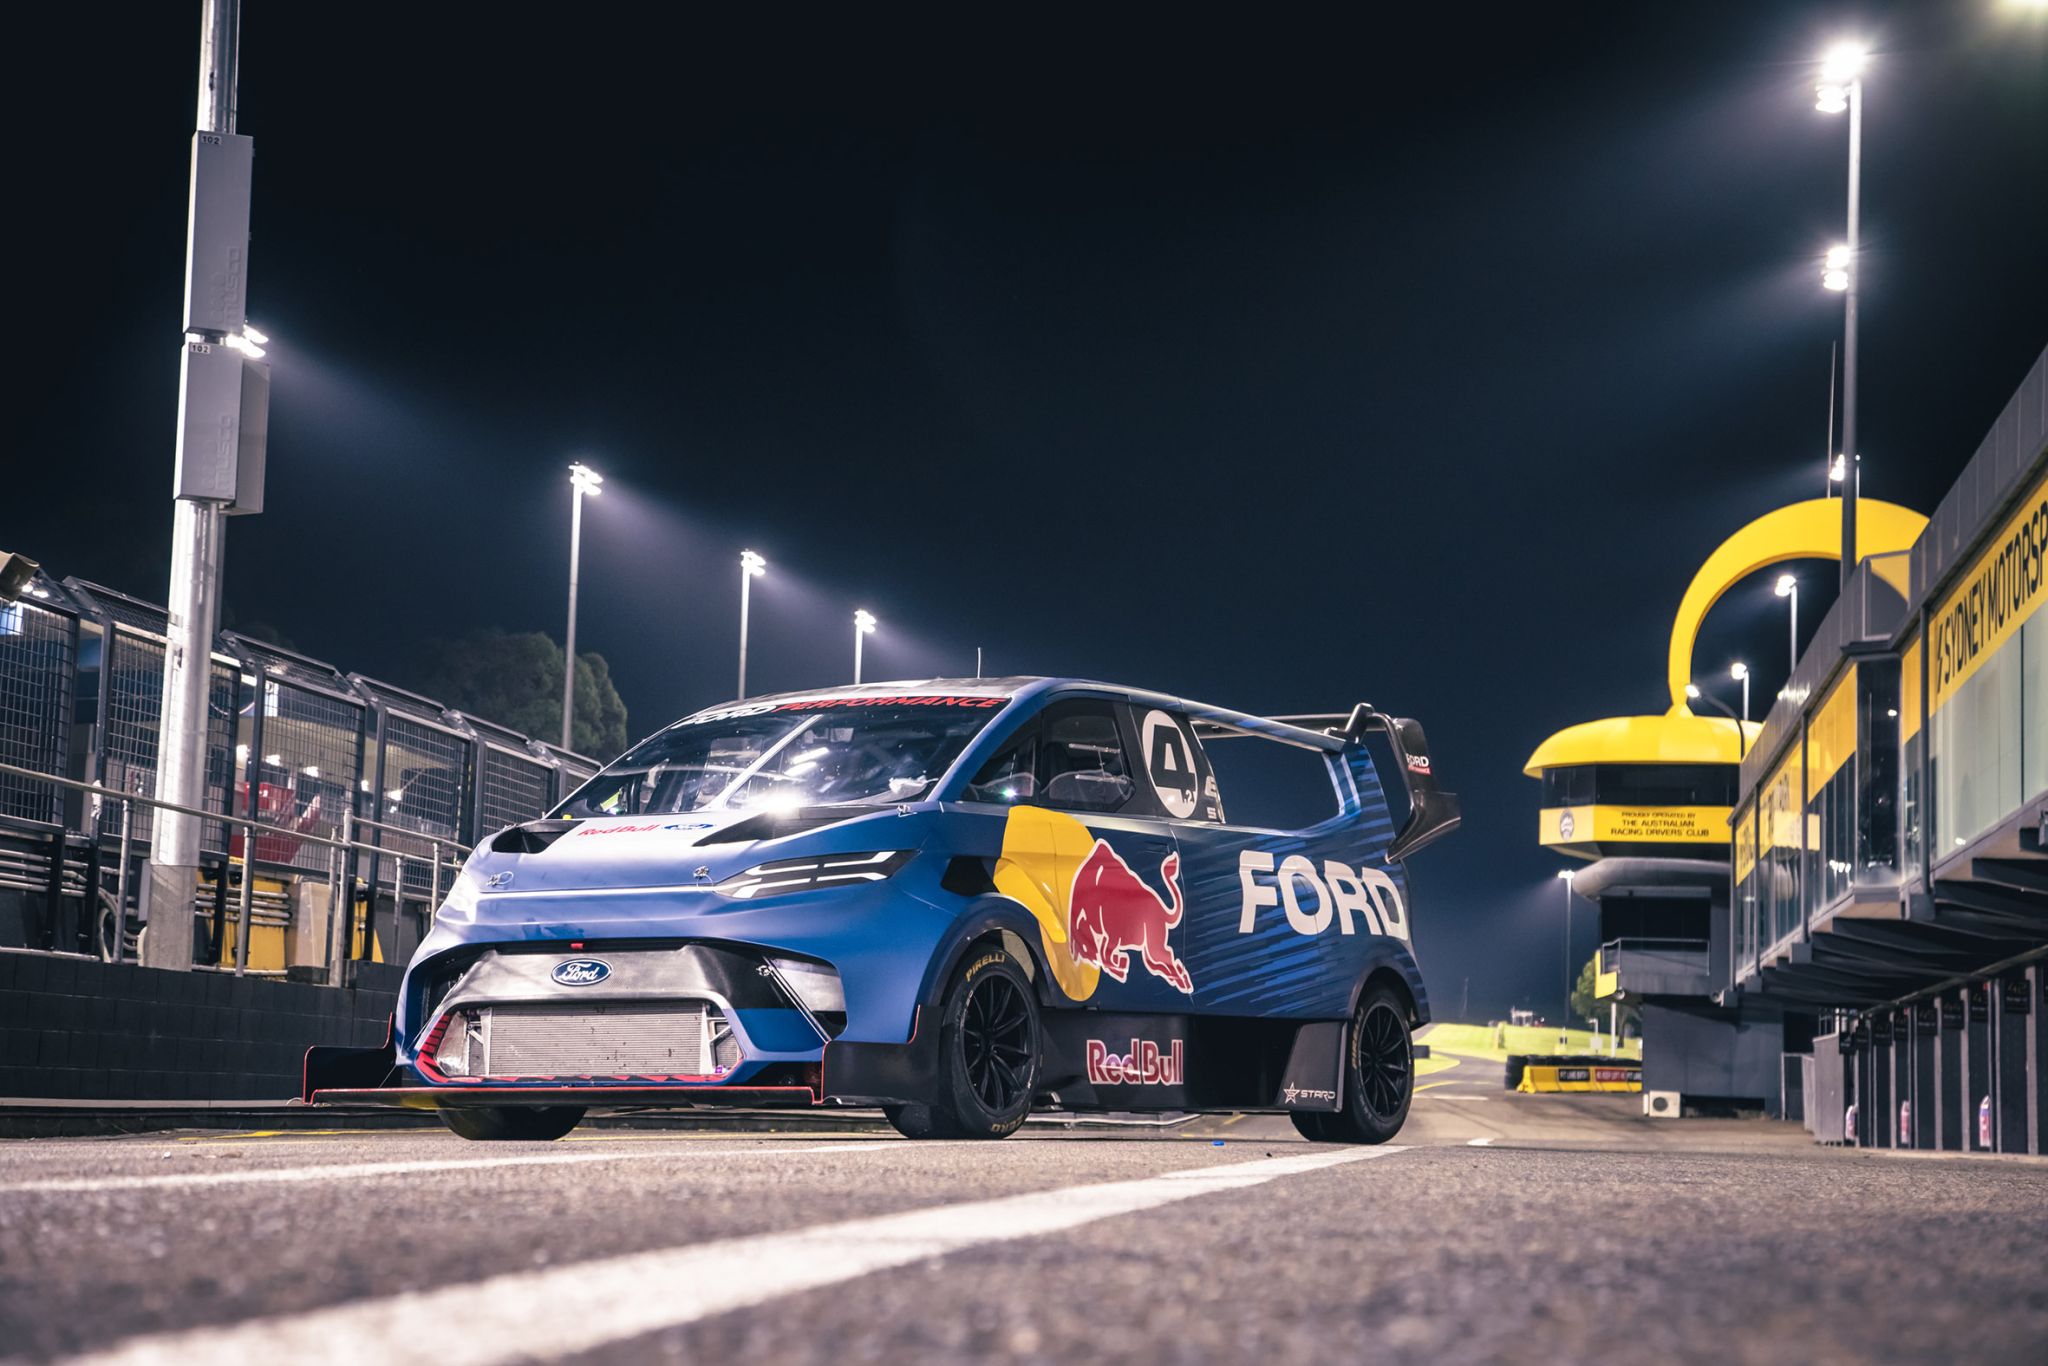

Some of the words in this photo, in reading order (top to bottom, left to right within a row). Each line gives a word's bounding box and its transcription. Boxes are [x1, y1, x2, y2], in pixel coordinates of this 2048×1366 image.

[202, 136, 220, 144] 102
[192, 345, 209, 353] 102
[1944, 573, 1986, 686] SYDNEY
[1988, 500, 2048, 640] MOTORSP
[771, 696, 1006, 713] PERFORMANCE
[1611, 827, 1643, 836] RACING
[1686, 829, 1710, 837] CLUB
[1641, 820, 1695, 828] AUSTRALIAN
[1238, 849, 1409, 941] FORD
[559, 962, 600, 981] Ford
[965, 953, 1006, 983] PIRELLI
[1086, 1038, 1141, 1086] Red
[1141, 1039, 1184, 1086] Bull
[1300, 1089, 1336, 1102] STARD
